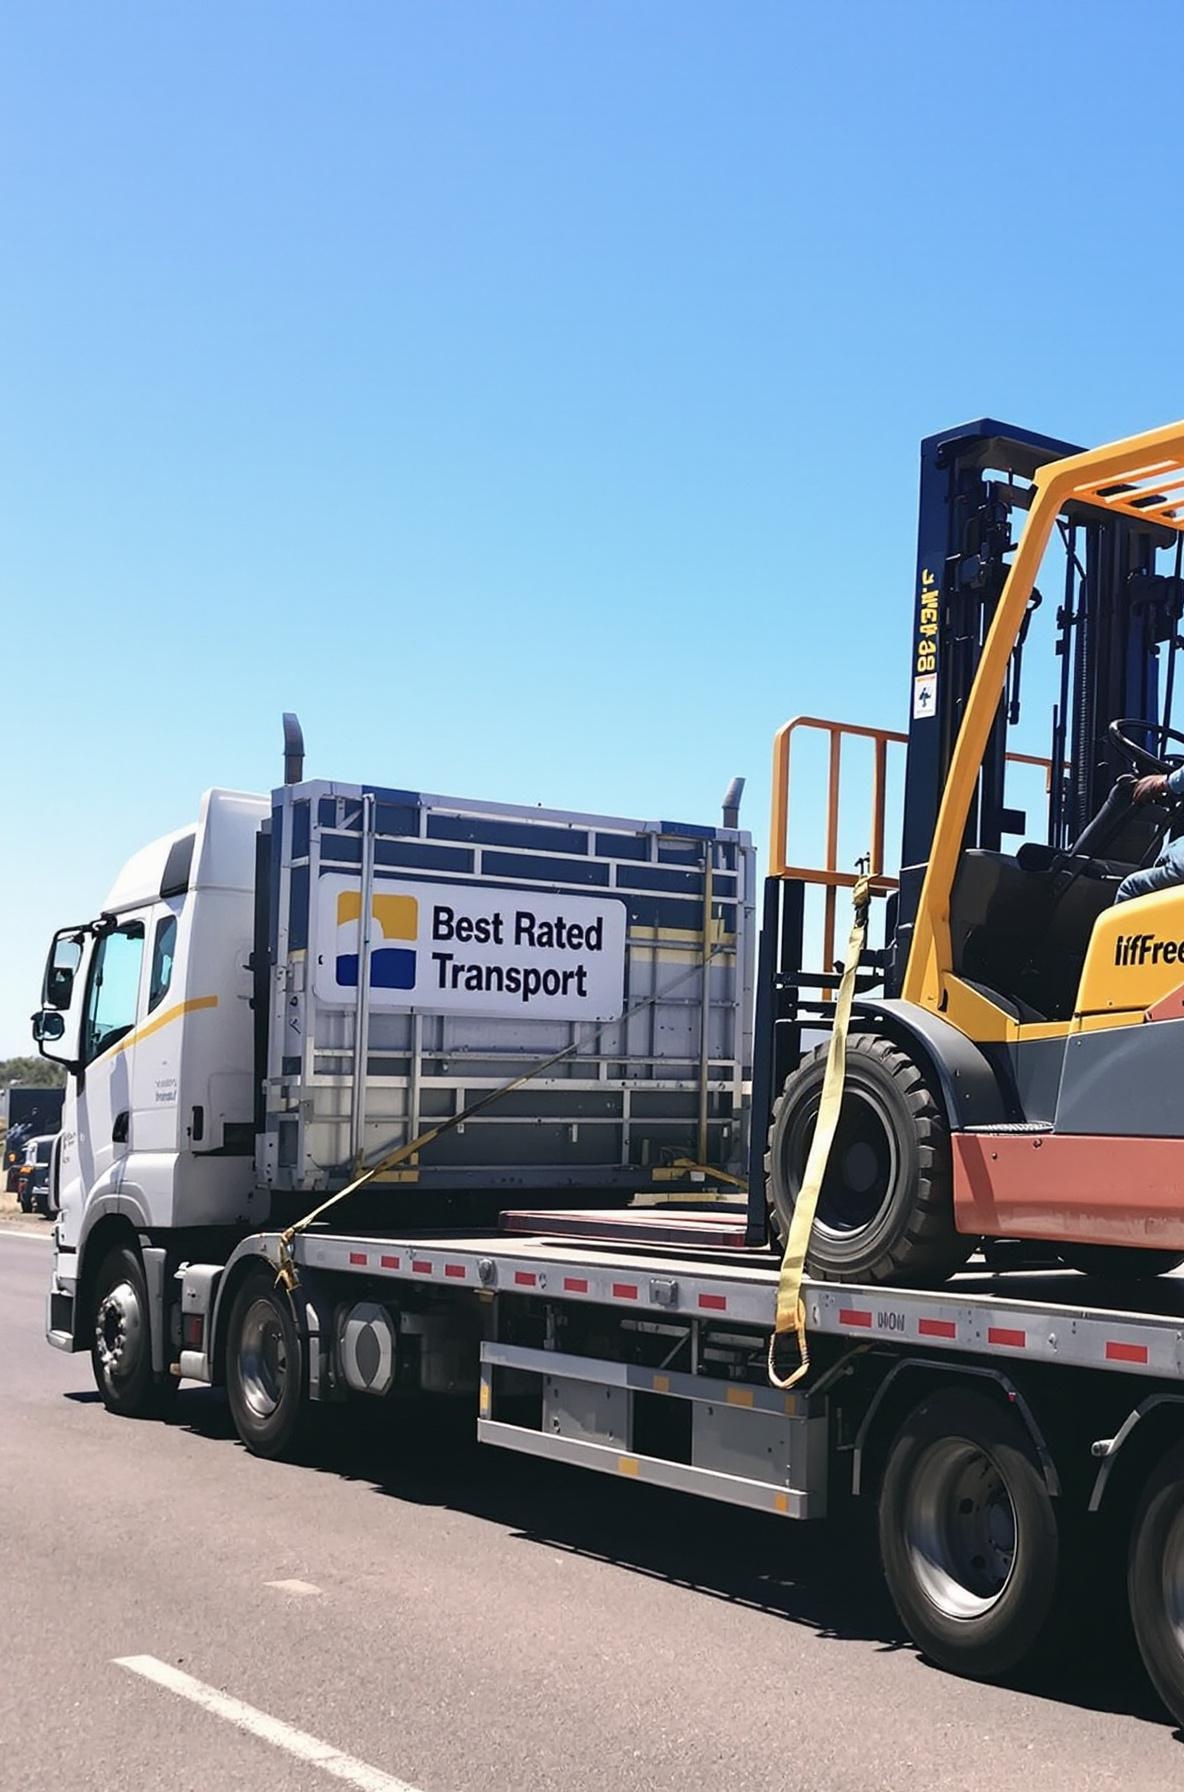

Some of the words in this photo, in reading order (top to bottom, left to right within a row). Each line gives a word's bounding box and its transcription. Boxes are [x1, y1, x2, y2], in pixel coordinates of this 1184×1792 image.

[432, 905, 503, 945] Best
[514, 911, 603, 951] Rated
[432, 952, 587, 1002] Transport
